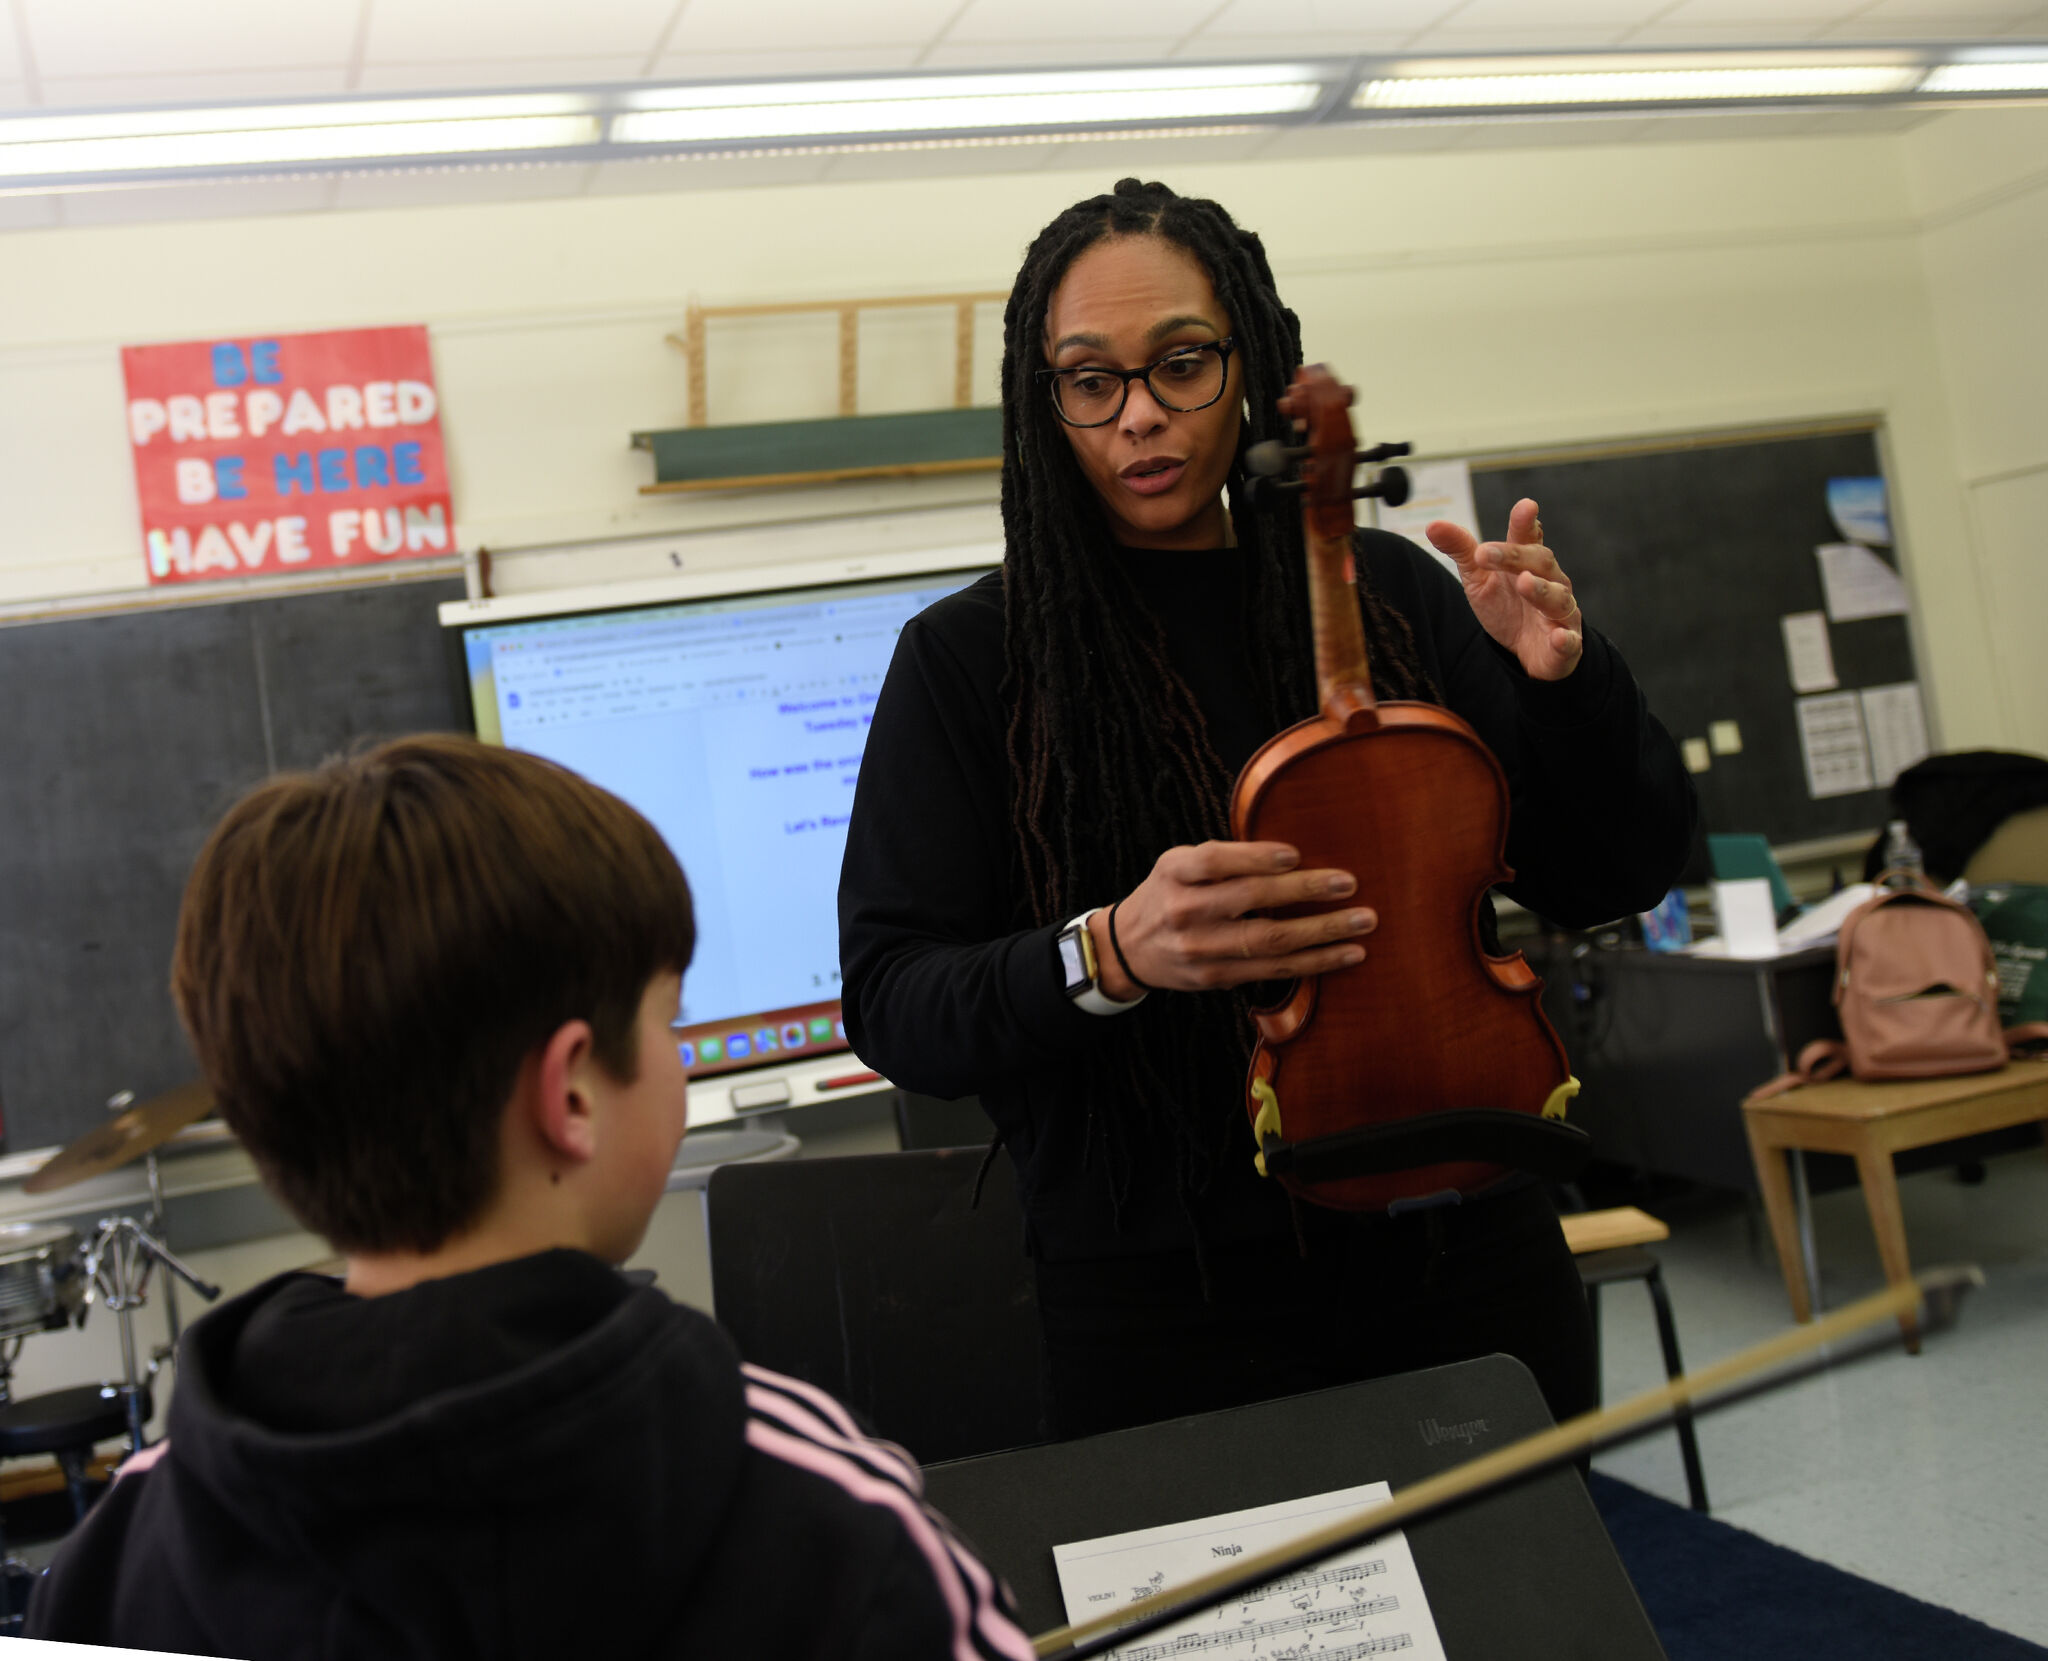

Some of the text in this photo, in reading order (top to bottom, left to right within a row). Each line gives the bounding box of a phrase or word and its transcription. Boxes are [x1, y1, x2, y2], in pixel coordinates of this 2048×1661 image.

[211, 341, 284, 388] BE
[130, 379, 438, 446] PREPARED
[175, 441, 425, 504] BE HERE
[148, 503, 448, 578] HAVE FUN
[777, 699, 837, 715] Welcome
[841, 696, 854, 706] to
[803, 715, 858, 734] Tuesday
[749, 766, 779, 780] How
[783, 762, 808, 774] was
[811, 757, 833, 771] the
[784, 816, 817, 834] Let's
[1211, 1543, 1243, 1558] Ninja
